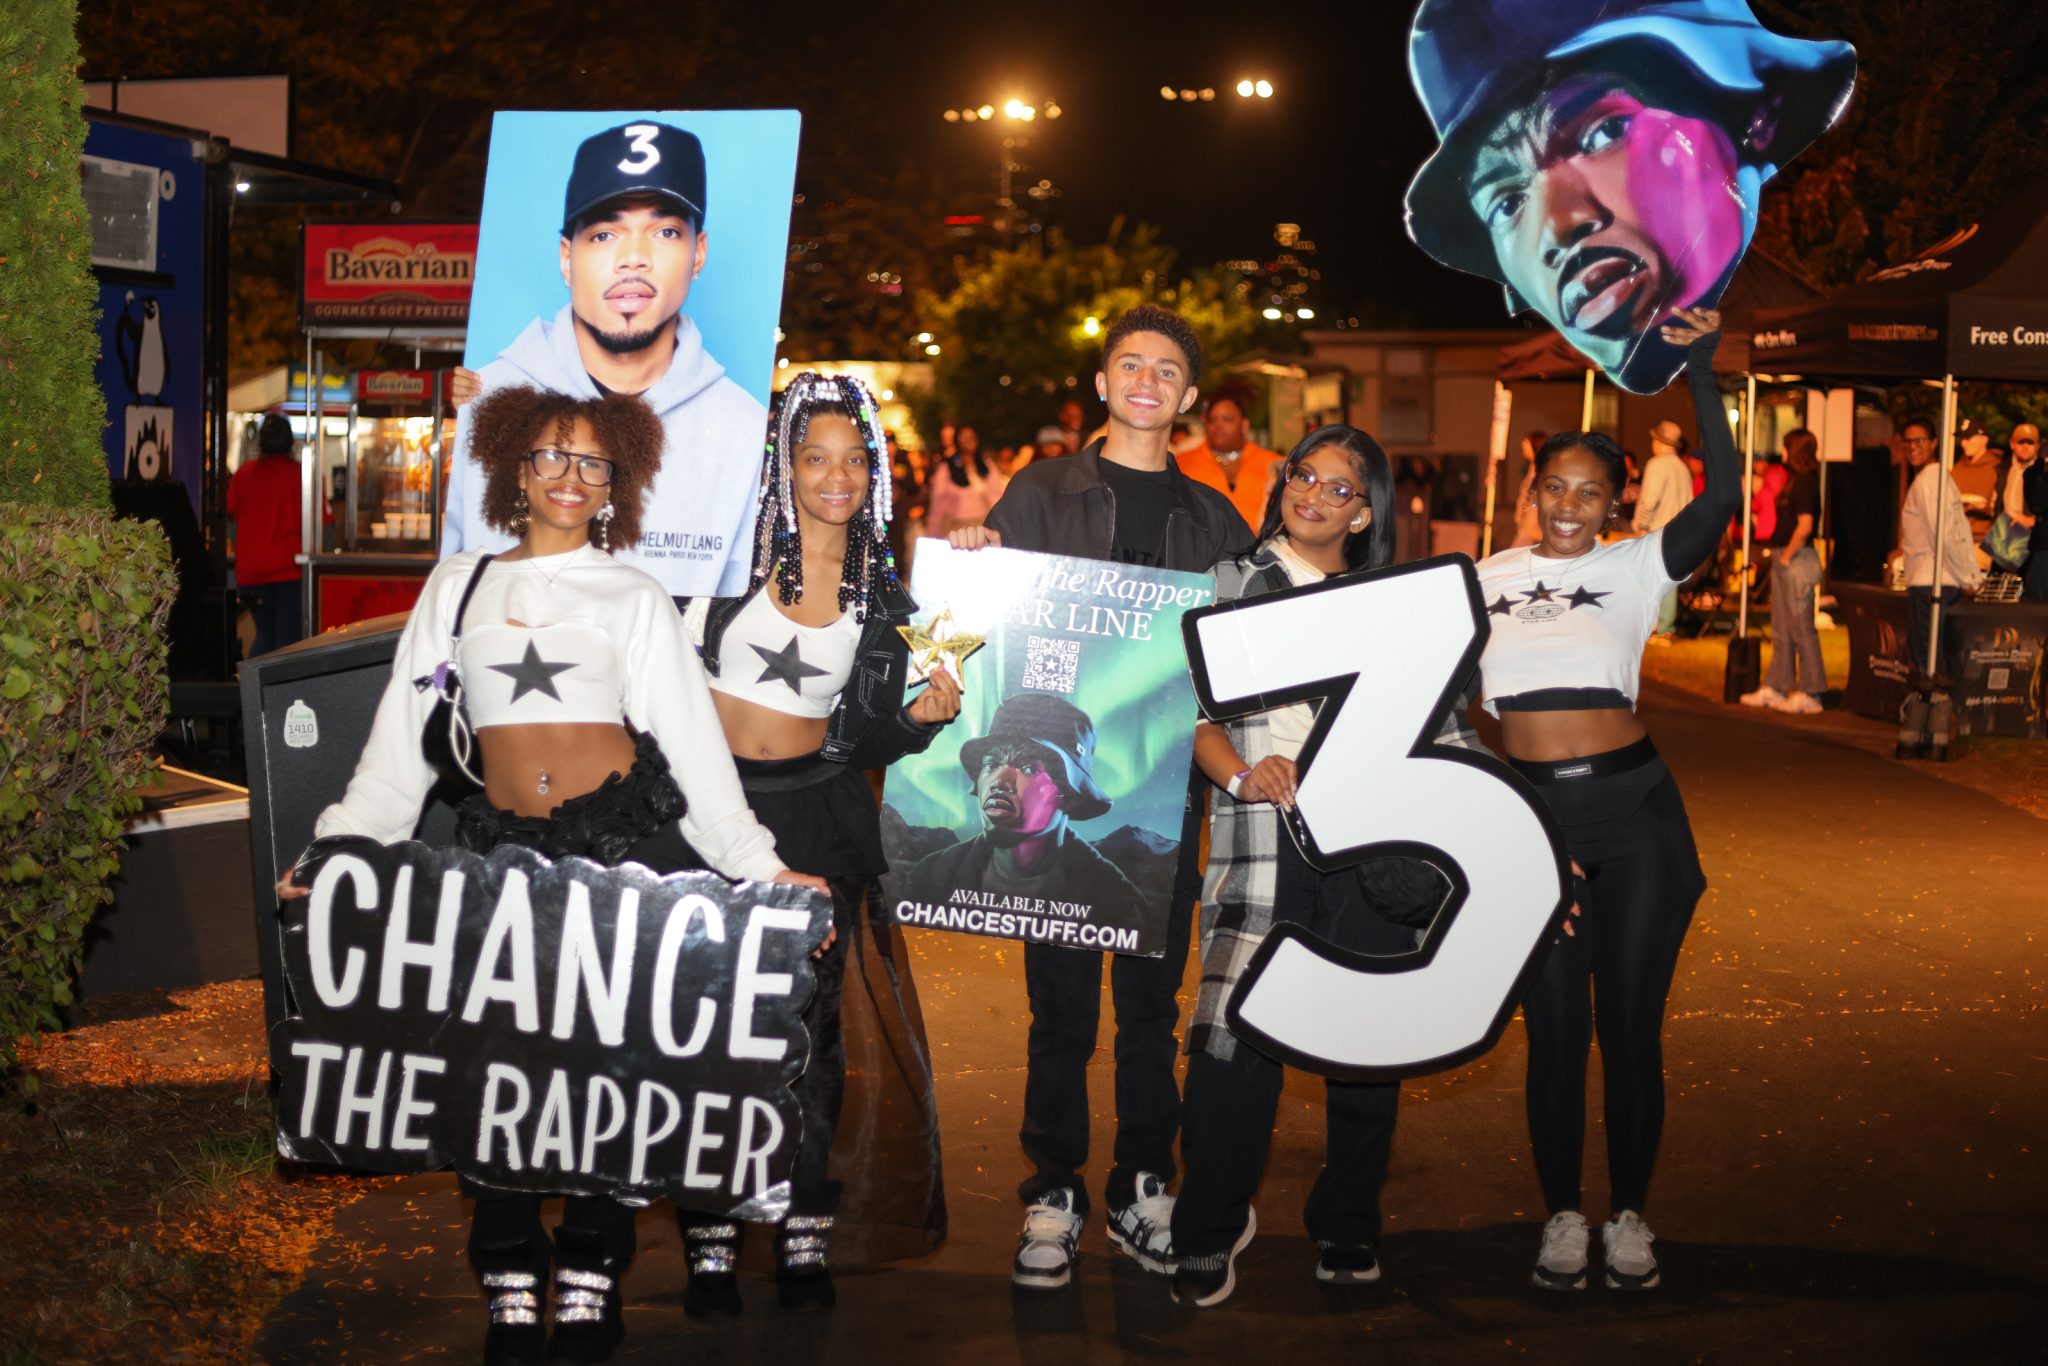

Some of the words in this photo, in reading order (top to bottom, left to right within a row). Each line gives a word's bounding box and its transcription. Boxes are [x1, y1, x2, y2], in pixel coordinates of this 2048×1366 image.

[617, 125, 660, 174] 3
[329, 250, 469, 280] Bavarian
[315, 305, 376, 317] GOURMET
[379, 305, 411, 317] SOFT
[415, 305, 466, 317] PRETZE
[1970, 326, 2009, 346] Free
[638, 531, 691, 549] HELMUT
[692, 535, 723, 551] LANG
[1092, 568, 1211, 612] Rapper
[1006, 596, 1057, 630] AR
[1065, 602, 1153, 642] LINE
[288, 723, 314, 734] 1410
[1192, 560, 1566, 1072] 3
[896, 899, 1139, 950] CHANCESTUFF.COM
[948, 888, 1045, 914] AVAILABLE
[1050, 900, 1092, 920] NOW
[306, 853, 812, 1062] CHANCE
[291, 1042, 447, 1151] THE
[476, 1062, 784, 1199] RAPPER
